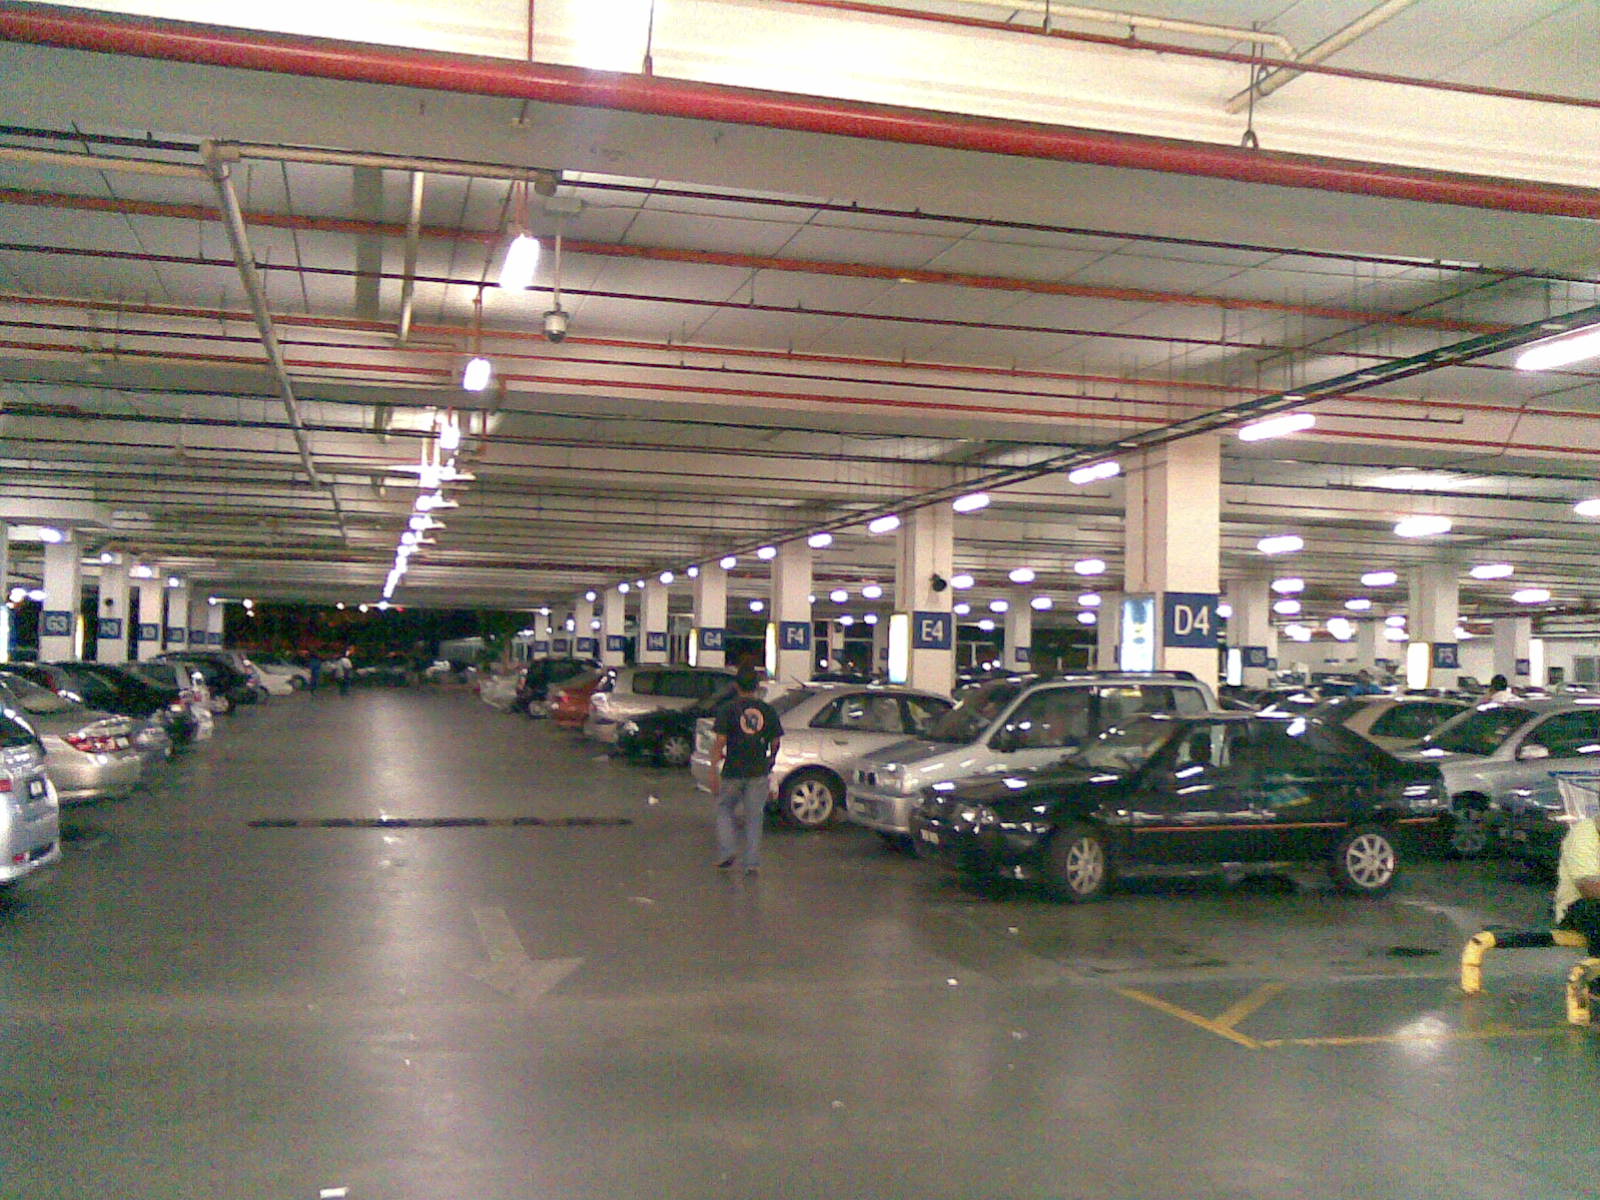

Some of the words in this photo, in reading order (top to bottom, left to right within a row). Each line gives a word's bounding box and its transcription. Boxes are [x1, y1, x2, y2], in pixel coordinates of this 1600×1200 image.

[1174, 604, 1210, 636] D4
[703, 631, 721, 647] G4
[786, 628, 804, 645] F4
[921, 620, 943, 641] E4
